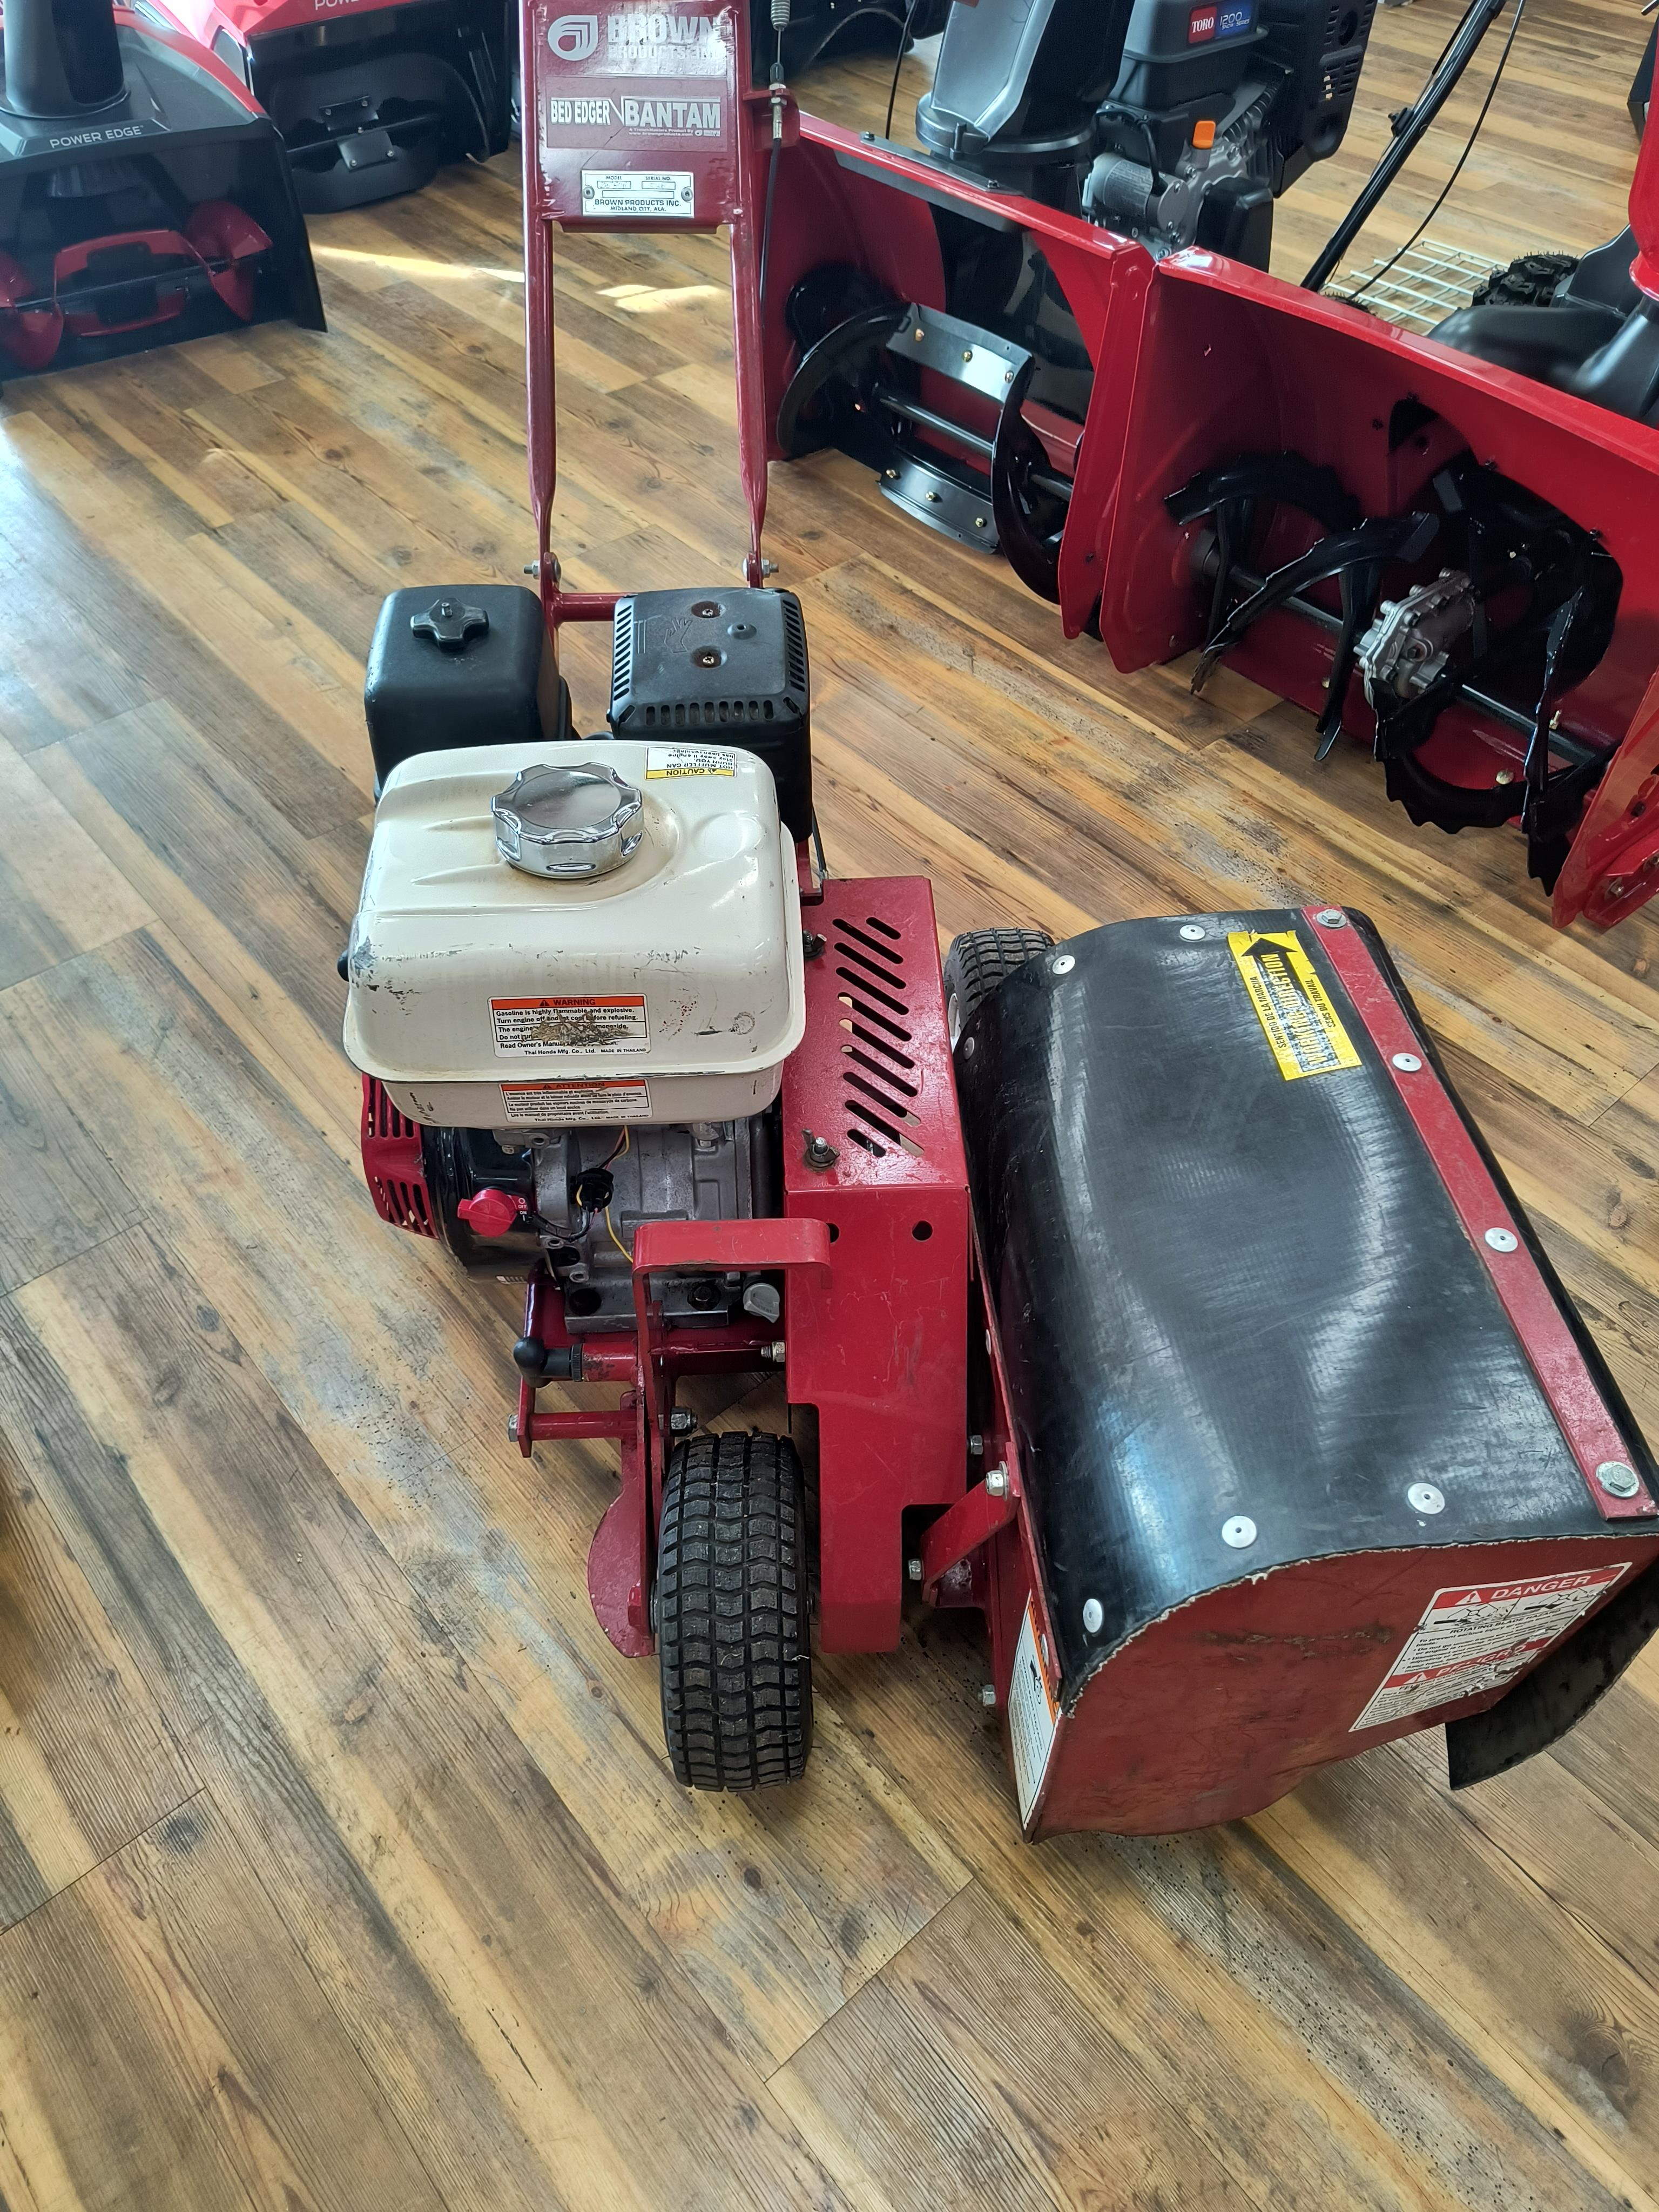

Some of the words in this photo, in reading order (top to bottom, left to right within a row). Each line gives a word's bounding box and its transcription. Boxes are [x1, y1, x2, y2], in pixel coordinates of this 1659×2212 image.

[608, 14, 720, 43] BROWN
[1192, 17, 1214, 33] TORO
[1220, 11, 1242, 26] 1200
[551, 100, 572, 124] BED
[574, 100, 611, 125] EDGER
[625, 100, 720, 128] BANTAM
[50, 132, 102, 149] POWER
[666, 768, 705, 776] CAUTION
[1260, 954, 1301, 1009] DIRECTION
[1305, 979, 1323, 1002] TRAVAIL
[1263, 1002, 1271, 1012] LA
[1266, 1013, 1275, 1021] DE
[1317, 1003, 1328, 1011] DU
[1269, 1021, 1286, 1048] SENTIDO
[1287, 1010, 1327, 1065] WORKING
[1491, 1575, 1591, 1600] DANGER
[1449, 1623, 1492, 1633] ROTATING
[1495, 1618, 1522, 1626] BLADE
[1526, 1609, 1560, 1619] HAZARD
